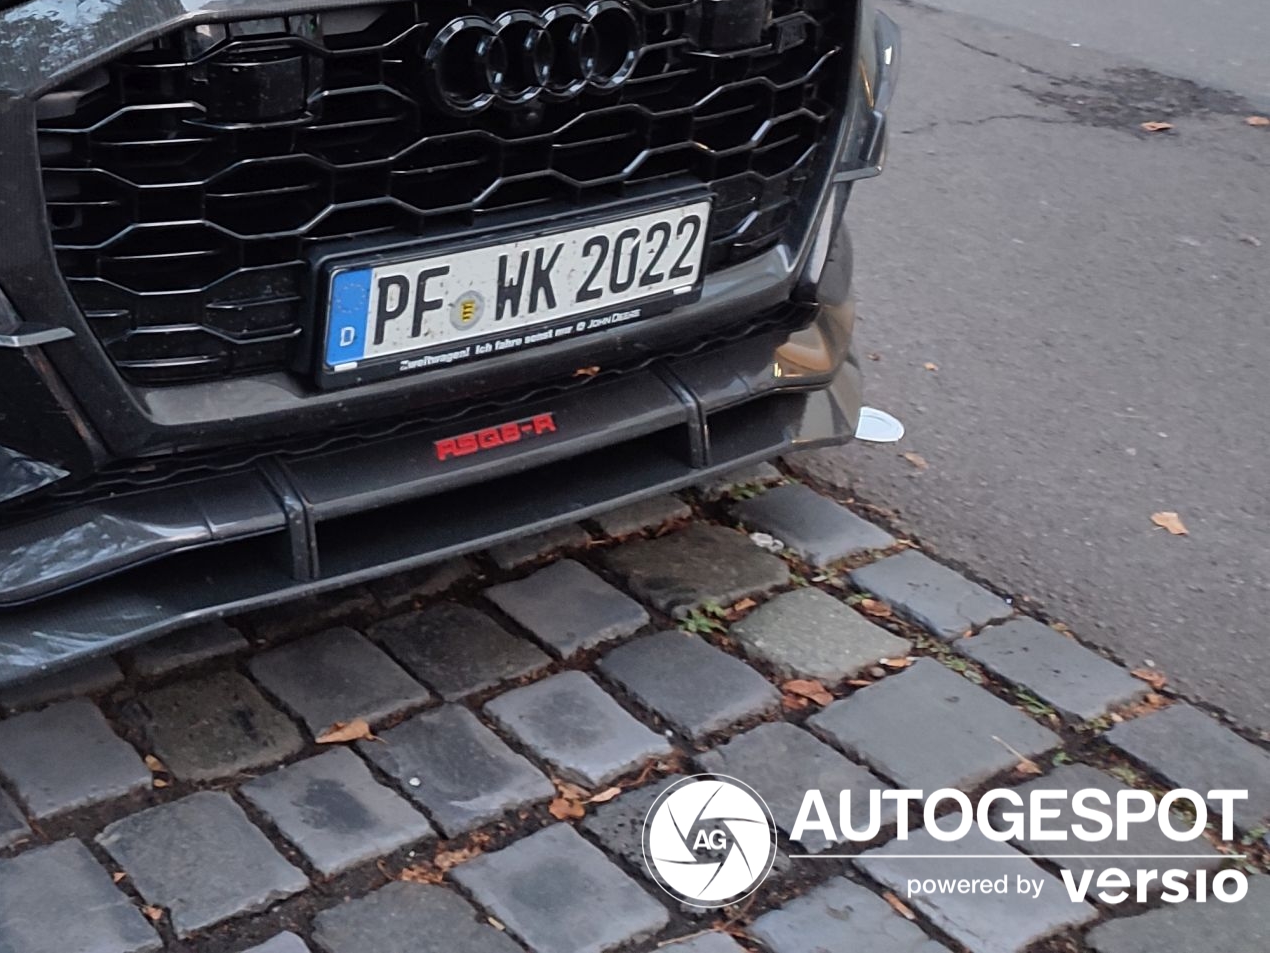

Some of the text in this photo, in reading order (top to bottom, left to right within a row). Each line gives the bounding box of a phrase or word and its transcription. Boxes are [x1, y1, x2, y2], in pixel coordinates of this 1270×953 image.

[373, 214, 701, 346] PF WK 2022
[340, 326, 354, 347] D
[475, 343, 492, 354] Ich
